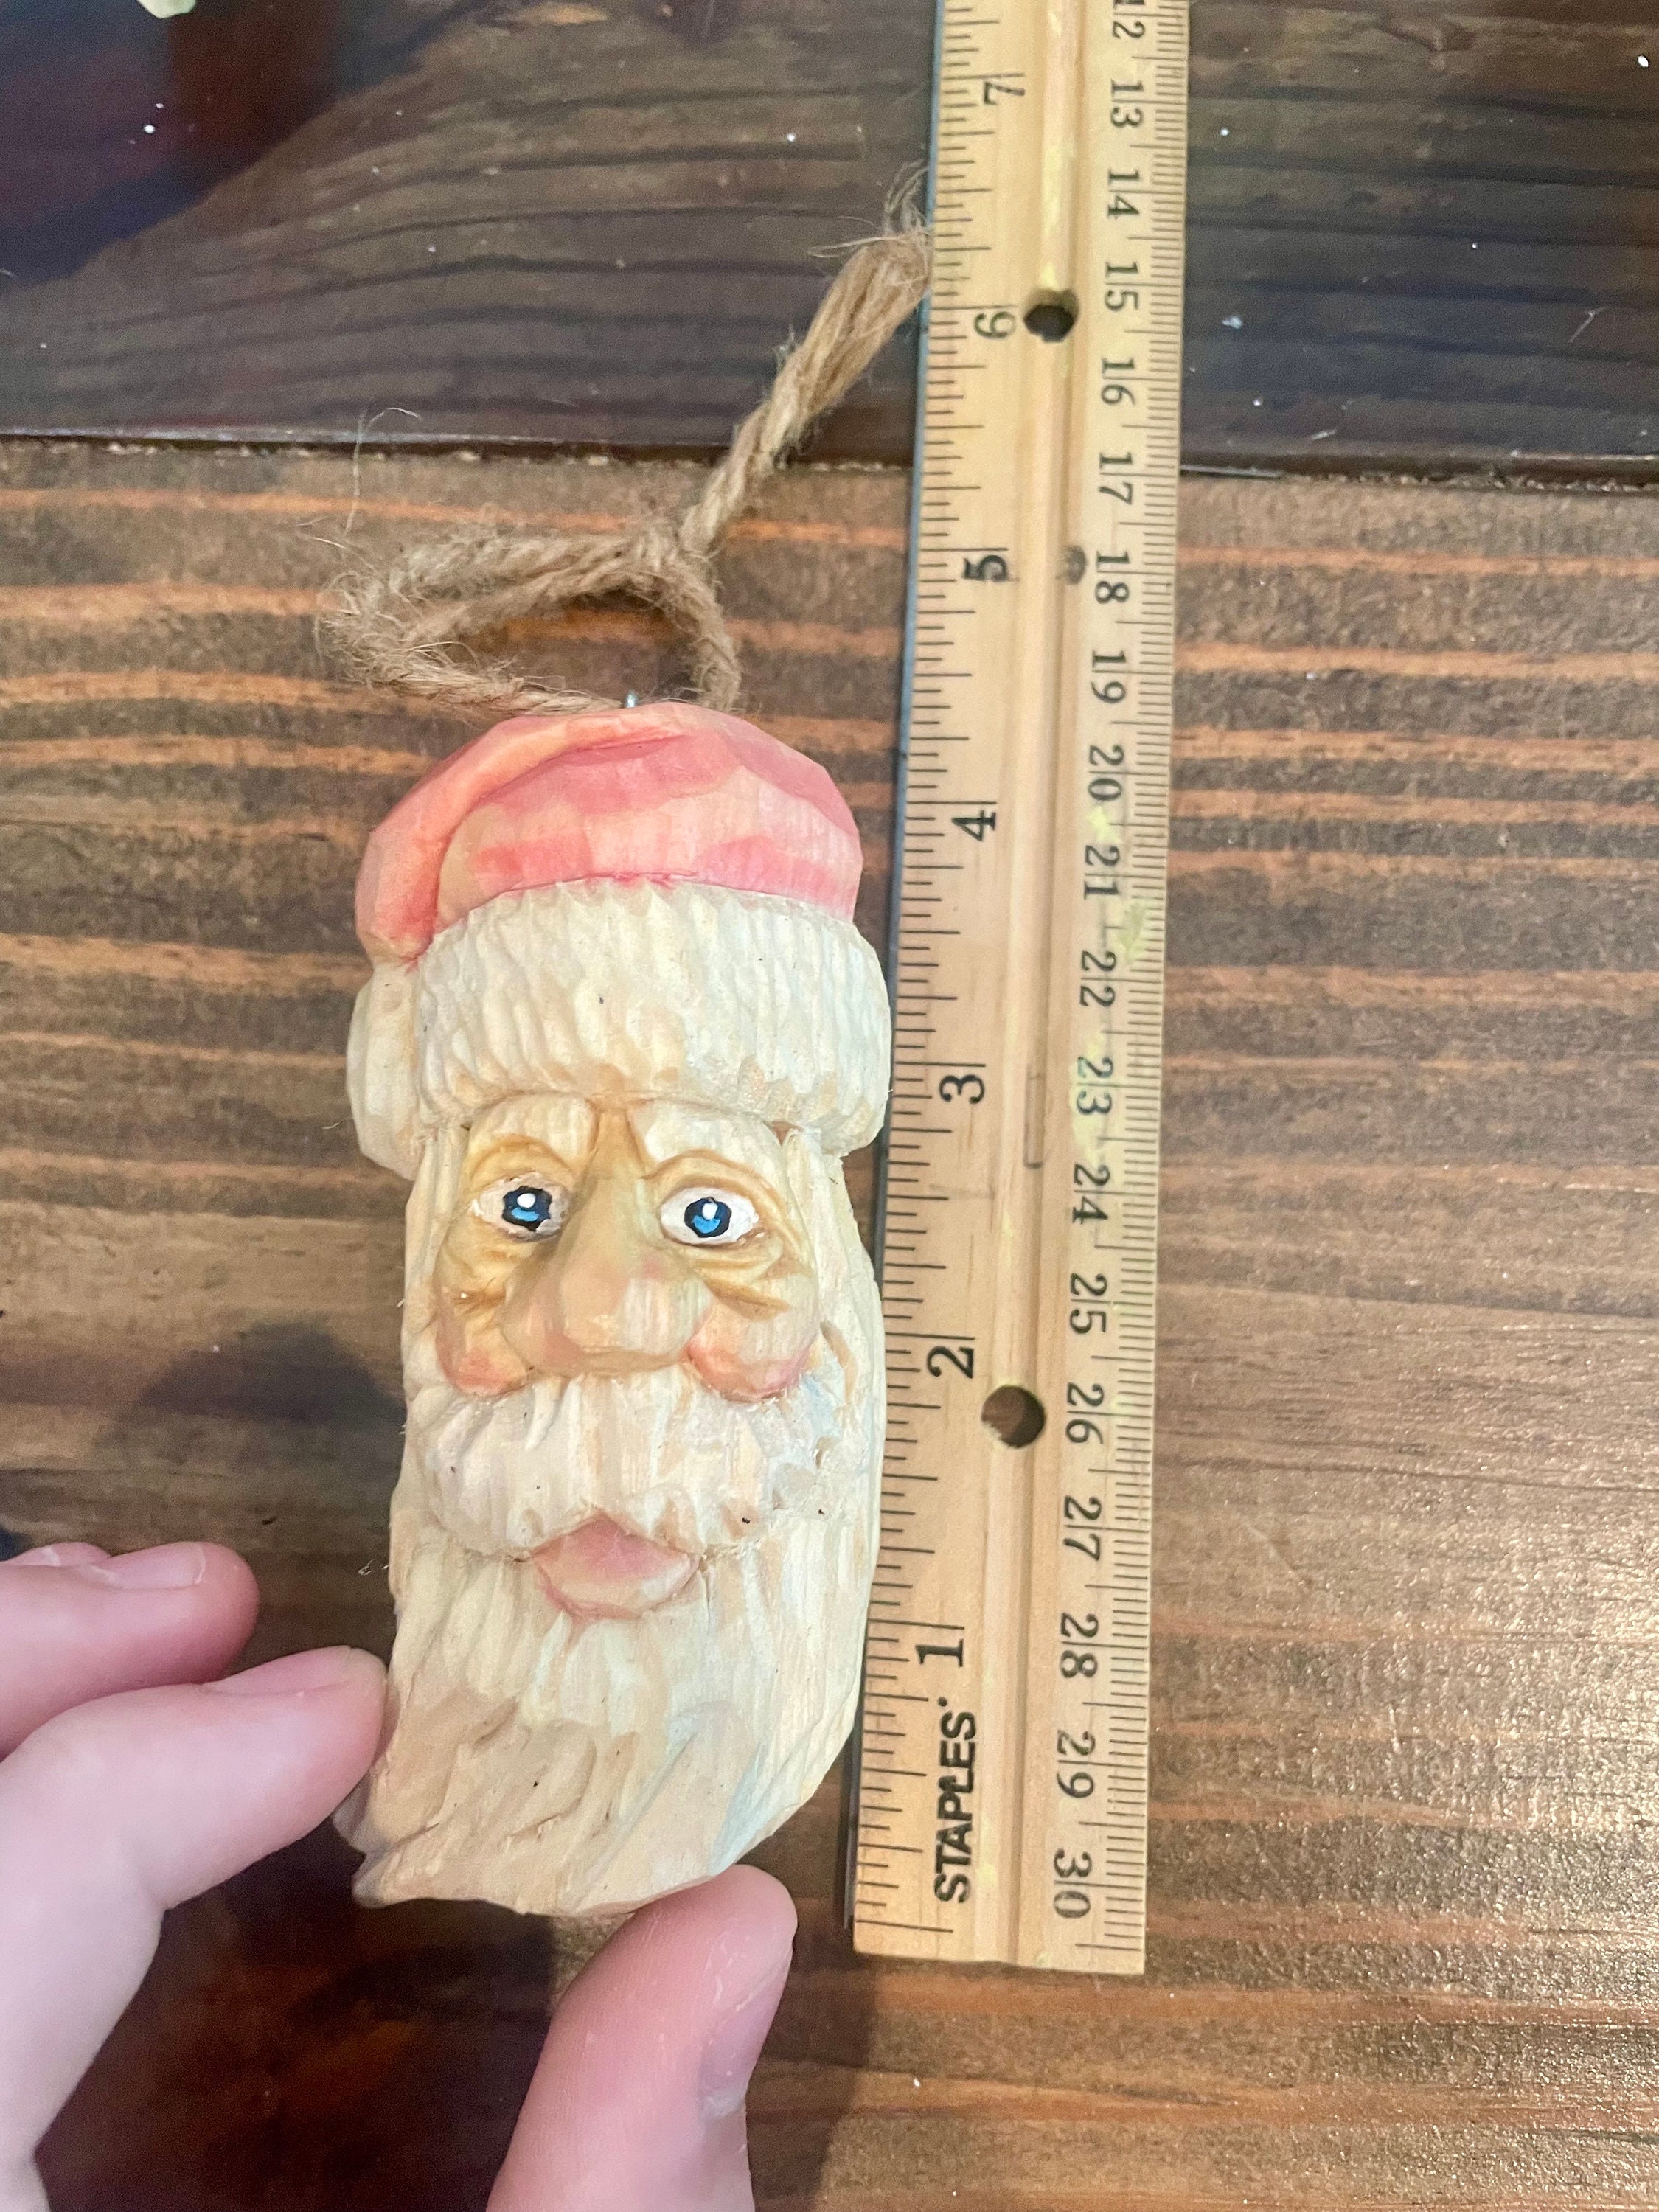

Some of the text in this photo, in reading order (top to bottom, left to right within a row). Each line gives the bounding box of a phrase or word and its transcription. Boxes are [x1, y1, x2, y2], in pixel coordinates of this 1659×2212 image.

[984, 81, 1025, 105] 7
[1110, 79, 1144, 128] 13
[1108, 170, 1141, 220] 14
[1106, 261, 1139, 311] 15
[974, 311, 1017, 338] 6
[1101, 358, 1135, 405] 16
[1099, 452, 1133, 505] 17
[963, 554, 1008, 582] 5
[1095, 551, 1130, 604] 18
[1091, 650, 1126, 703] 19
[1088, 745, 1124, 801] 20
[951, 810, 996, 841] 4
[1084, 845, 1120, 900] 21
[1080, 950, 1116, 1006] 22
[939, 1074, 984, 1104] 3
[1076, 1056, 1113, 1116] 23
[1072, 1164, 1110, 1225] 24
[1070, 1273, 1106, 1334] 25
[927, 1346, 975, 1378] 2
[1066, 1382, 1104, 1444] 26
[1063, 1496, 1102, 1561] 27
[915, 1639, 964, 1667] 1
[1060, 1613, 1099, 1678] 28
[1057, 1730, 1095, 1798] 29
[933, 1711, 977, 1903] STAPLES
[1054, 1848, 1093, 1919] 30
